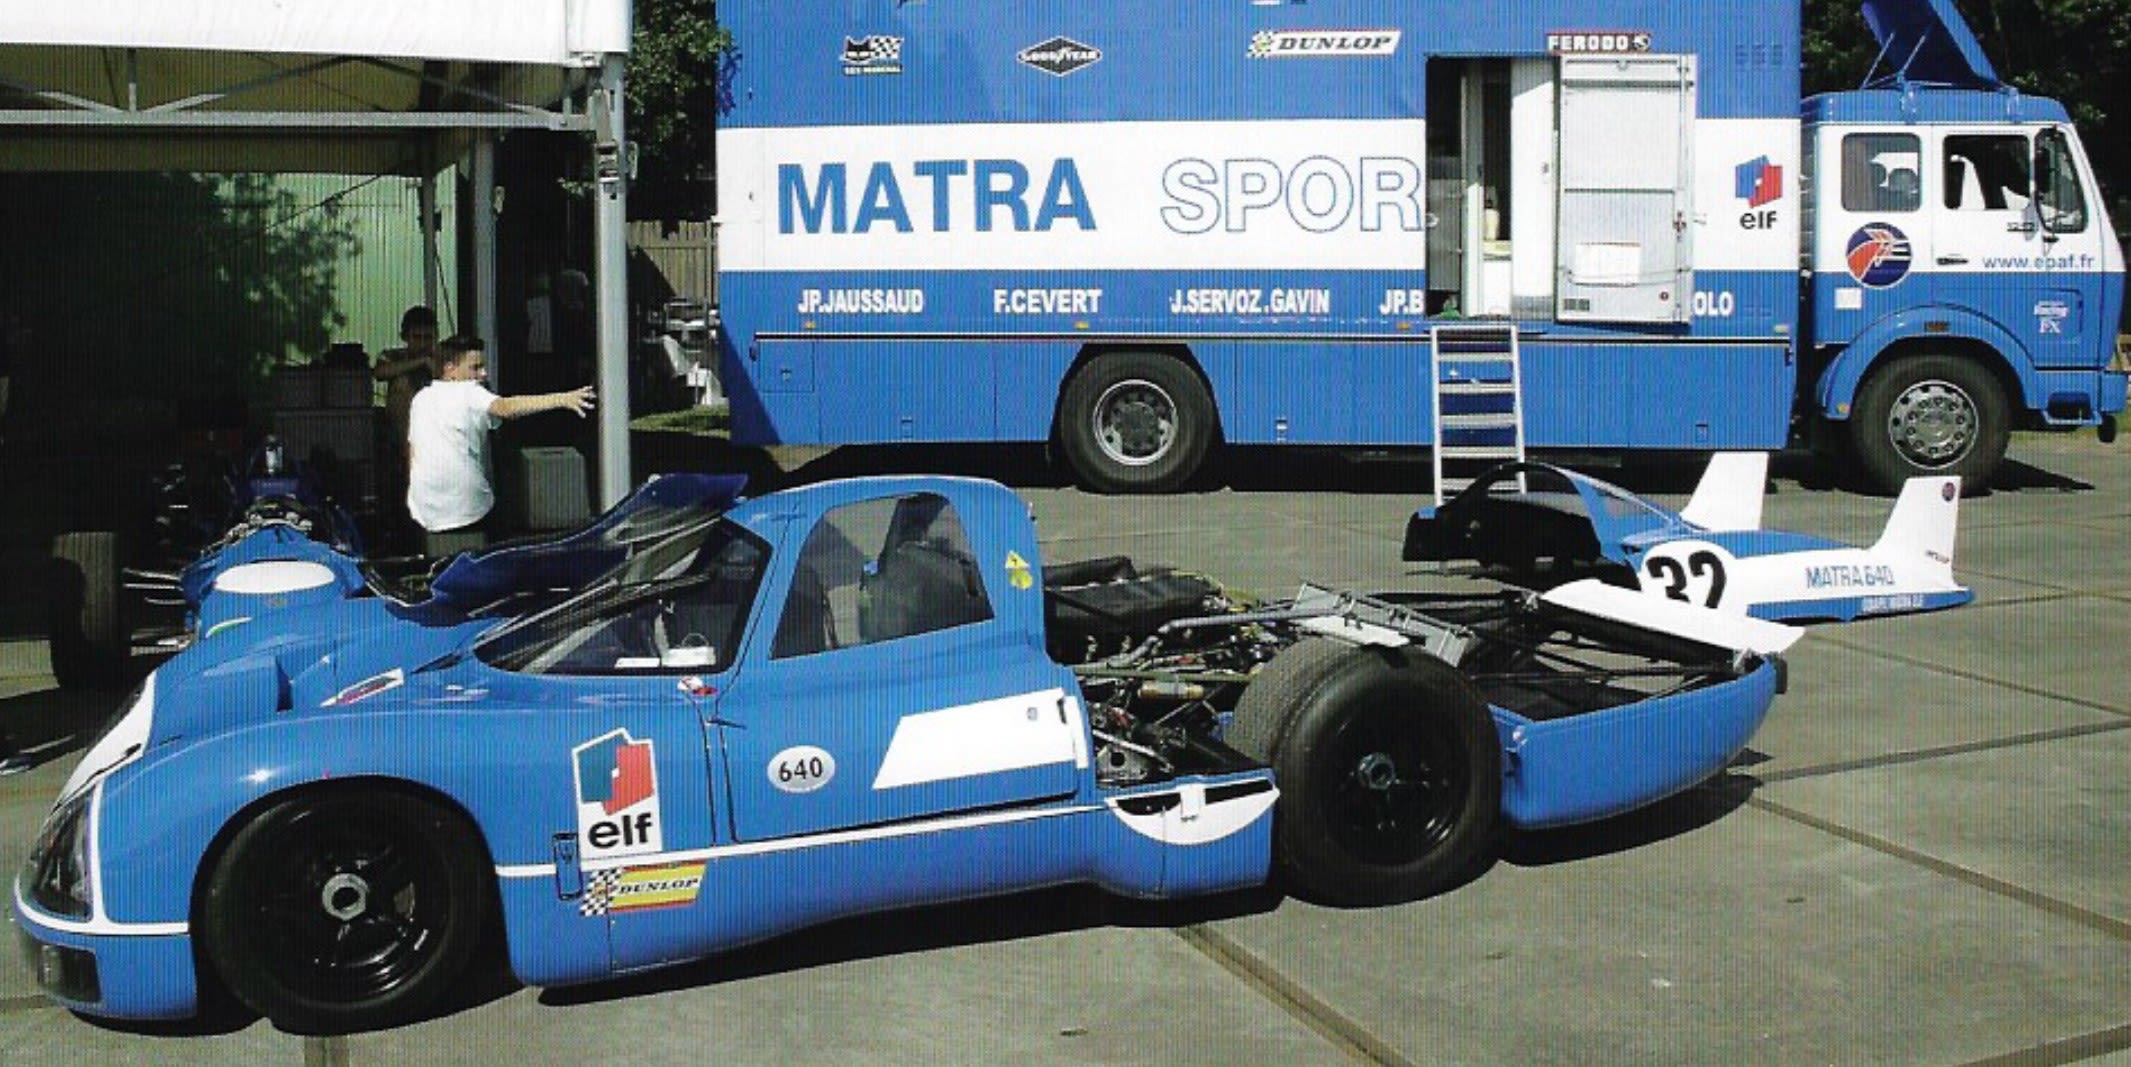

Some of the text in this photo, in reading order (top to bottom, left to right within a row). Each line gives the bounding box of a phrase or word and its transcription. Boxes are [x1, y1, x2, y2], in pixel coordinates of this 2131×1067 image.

[1022, 48, 1098, 63] GOODYEAR
[1278, 36, 1392, 51] DUNLOP
[1547, 34, 1629, 51] FERODO
[778, 155, 1423, 235] MATRA SPOR
[1739, 210, 1777, 230] elf
[1982, 252, 2095, 269] www.epaf.fr
[797, 288, 924, 314] JP.JAUSSAUD
[993, 288, 1103, 314] F.CEVERT
[1693, 290, 1734, 316] OLO
[1805, 564, 1896, 590] MATRA 640
[777, 756, 823, 783] 640
[587, 812, 654, 850] elf
[619, 877, 699, 895] DUNLOP
